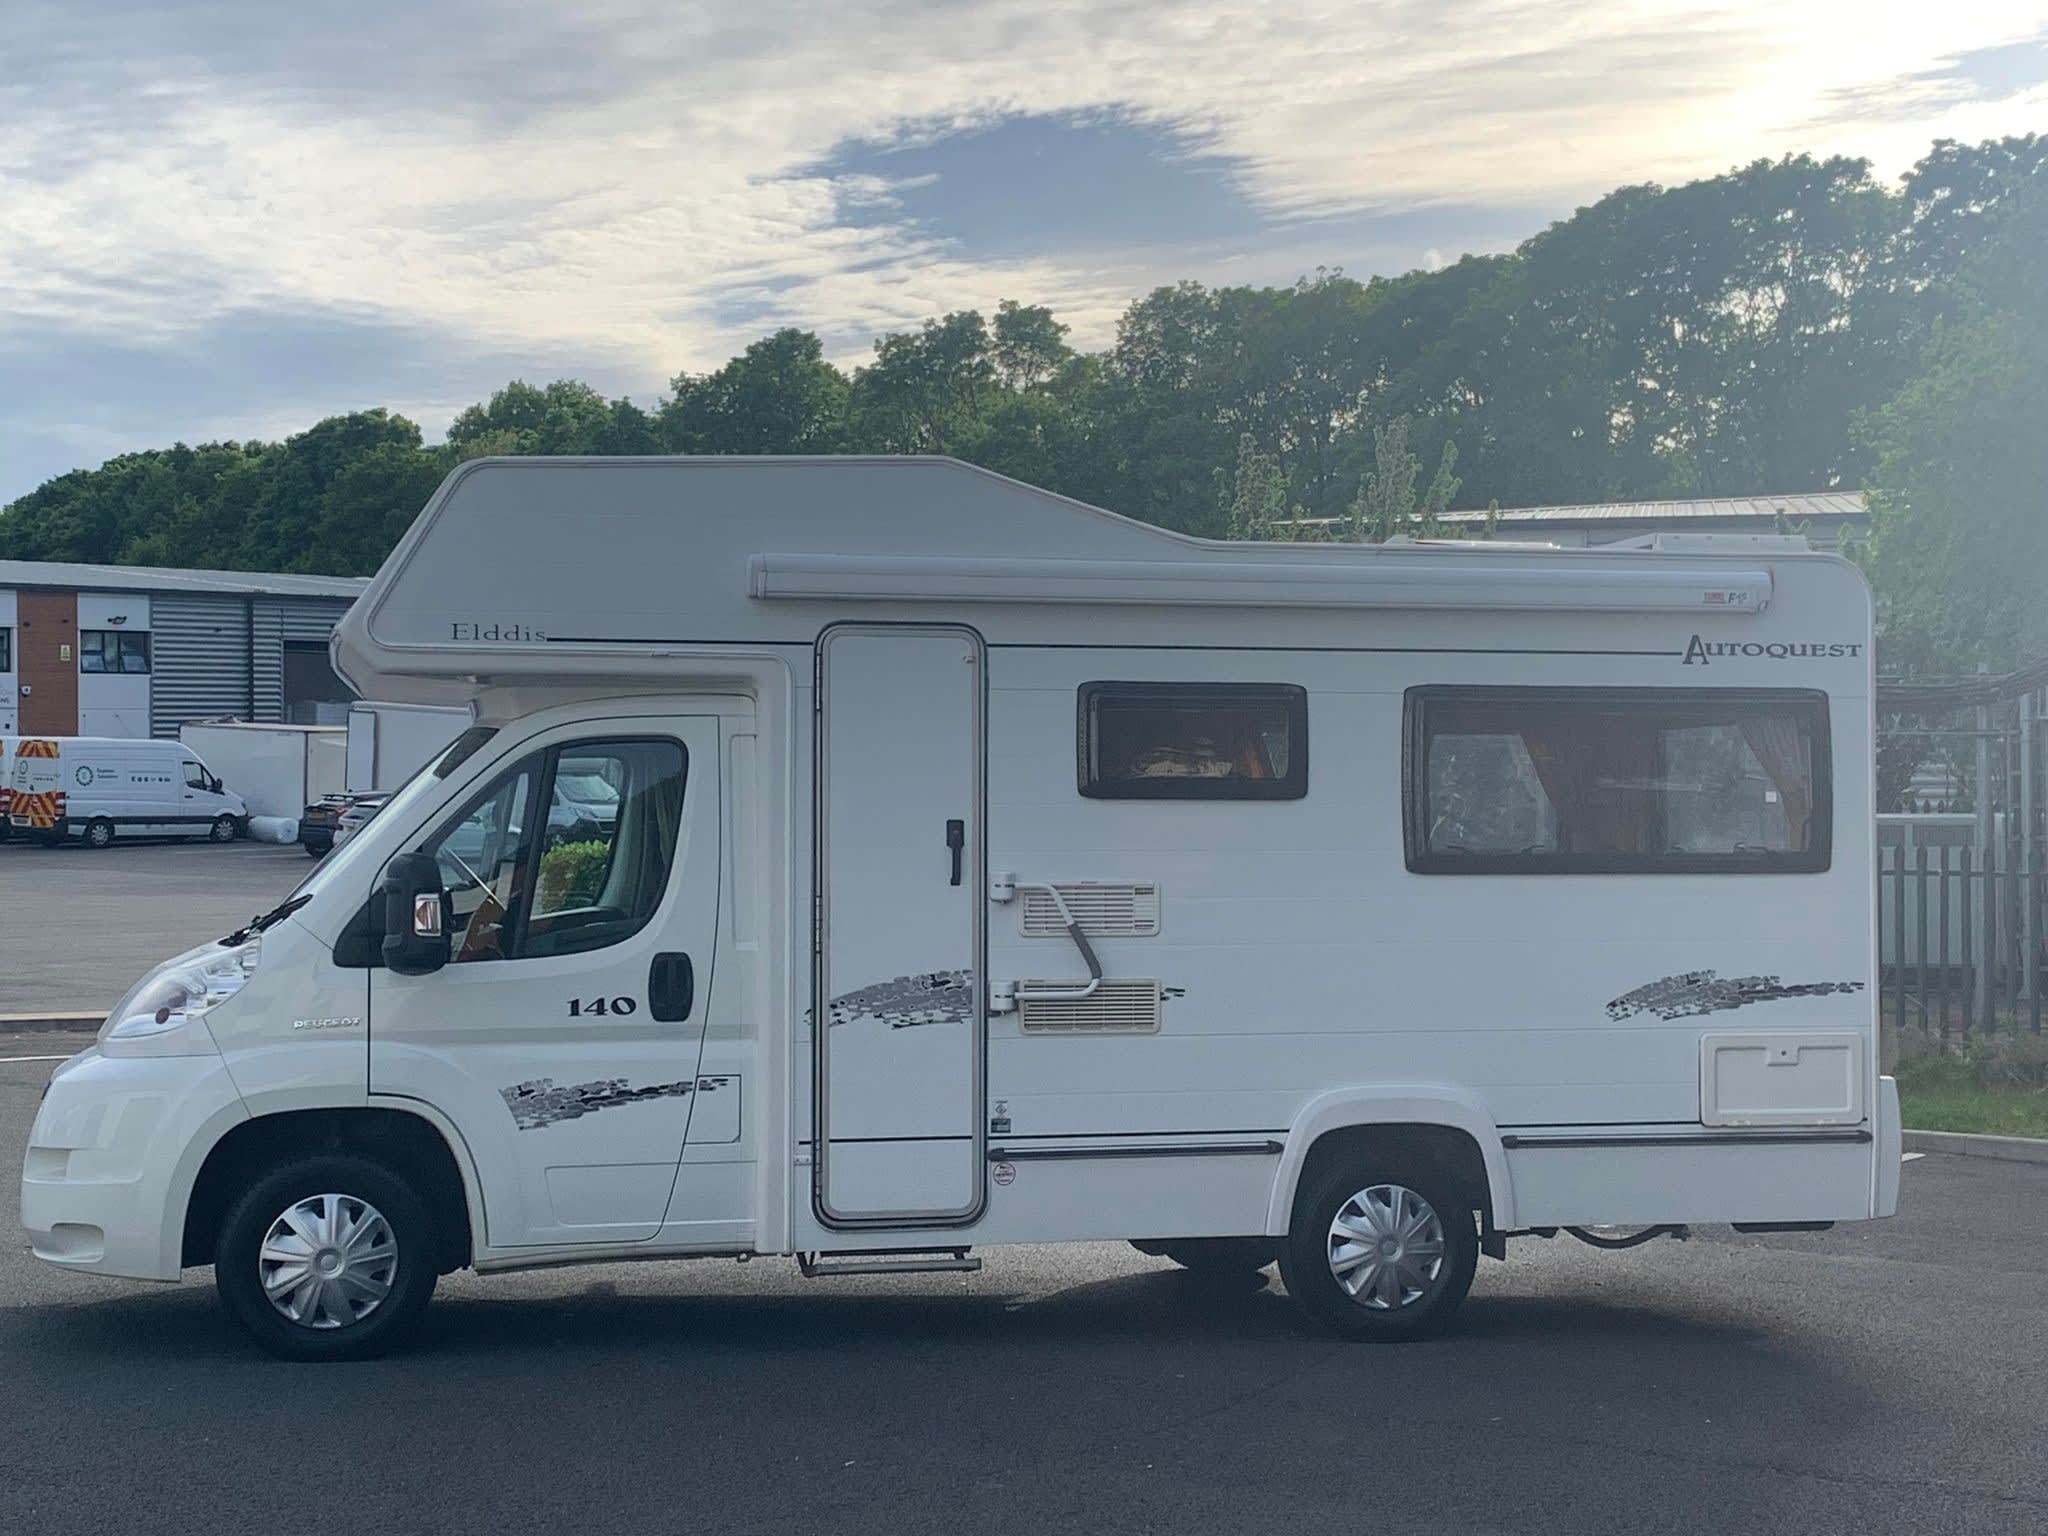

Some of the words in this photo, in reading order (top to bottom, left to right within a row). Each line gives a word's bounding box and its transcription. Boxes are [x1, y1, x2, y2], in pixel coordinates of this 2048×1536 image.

[451, 622, 546, 642] Elddis
[1682, 634, 1862, 665] AUTOQUEST
[567, 996, 637, 1017] 140
